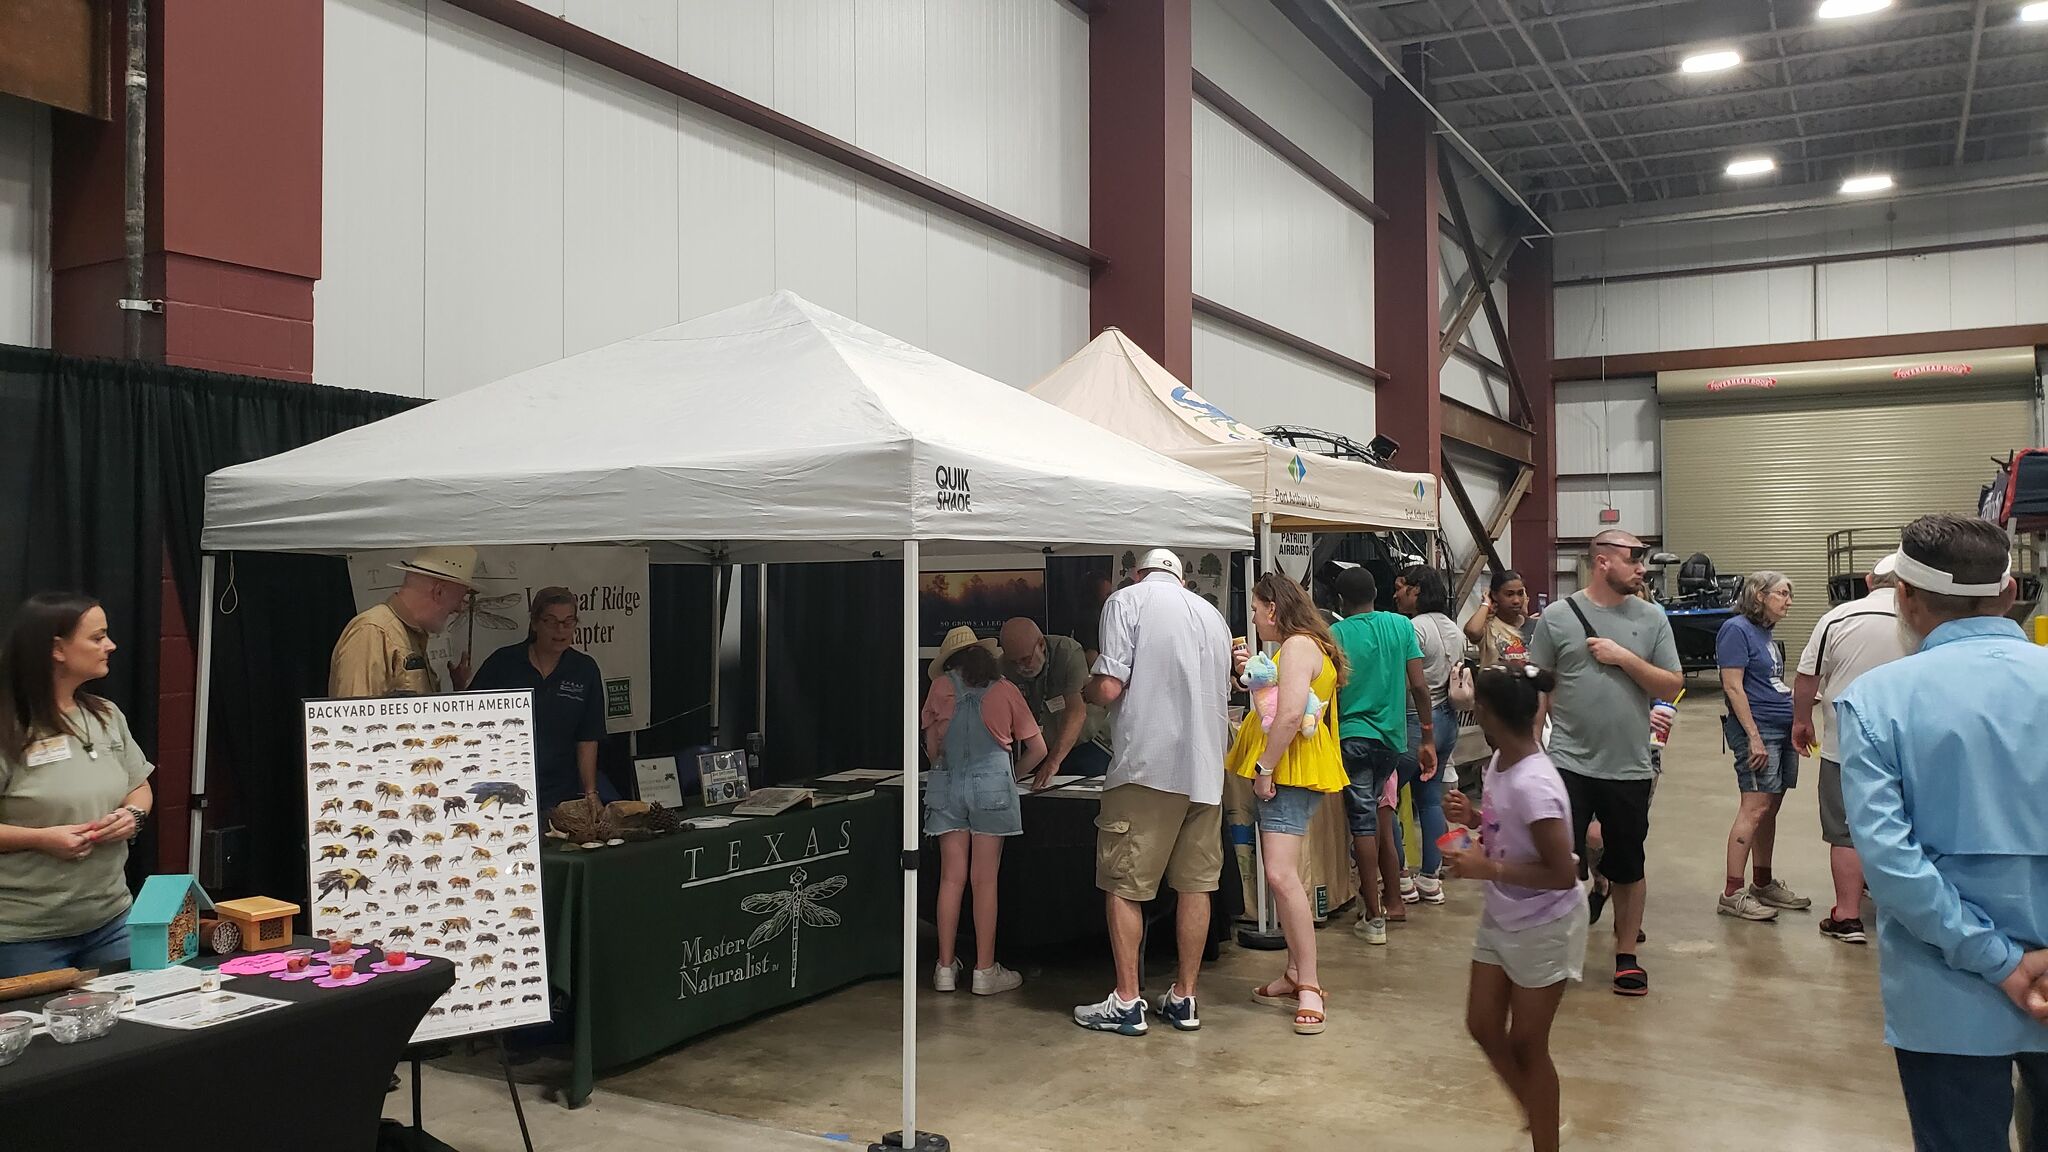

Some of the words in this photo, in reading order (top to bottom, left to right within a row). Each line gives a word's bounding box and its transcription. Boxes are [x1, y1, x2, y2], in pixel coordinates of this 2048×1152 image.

[936, 465, 970, 491] QUIK
[1279, 544, 1309, 556] AIRBOATS
[1281, 532, 1307, 544] PATRIOT
[602, 586, 640, 616] Ridge
[608, 684, 629, 692] TEXAS
[308, 703, 376, 719] BACKYARD
[380, 702, 409, 716] BEES
[413, 702, 429, 714] OF
[433, 699, 474, 713] NORTH
[478, 697, 531, 711] AMERICA
[683, 820, 851, 881] TEXAS
[680, 936, 745, 970] Master
[678, 951, 770, 1000] Naturalist
